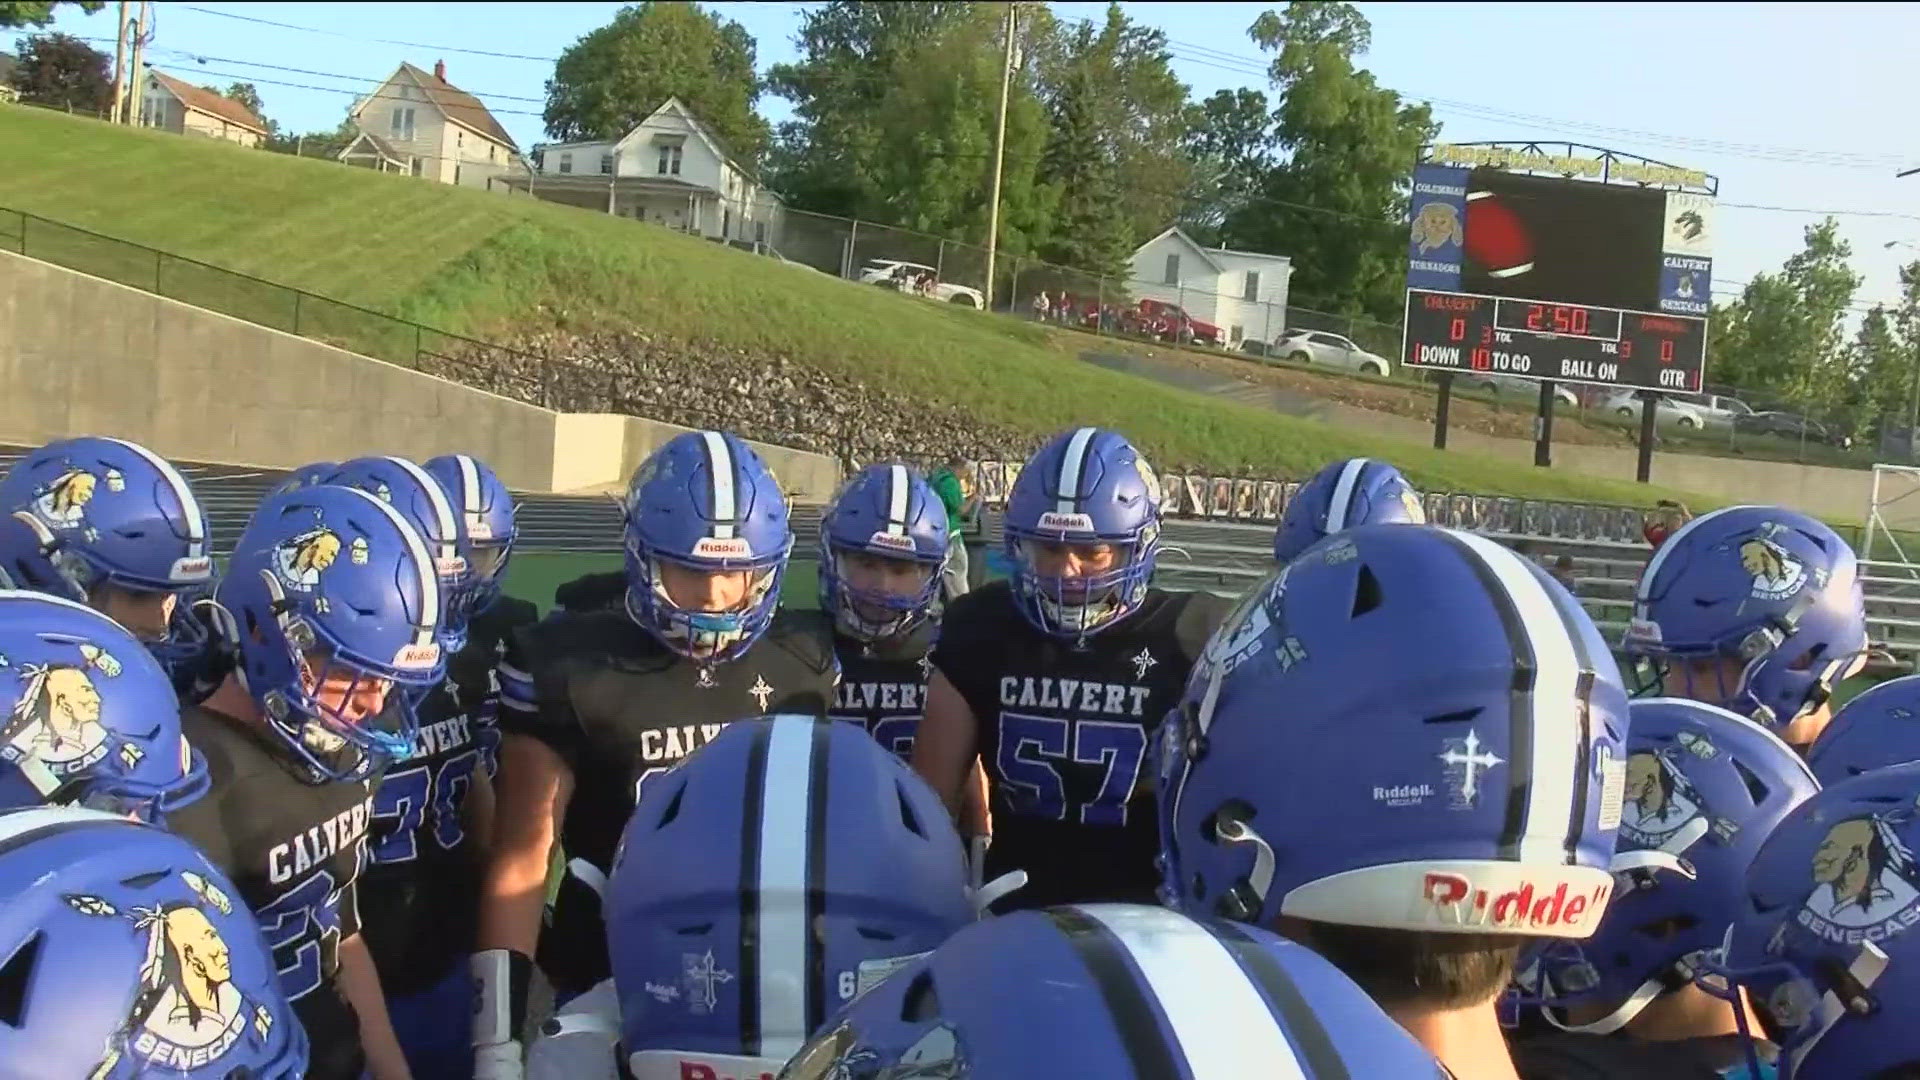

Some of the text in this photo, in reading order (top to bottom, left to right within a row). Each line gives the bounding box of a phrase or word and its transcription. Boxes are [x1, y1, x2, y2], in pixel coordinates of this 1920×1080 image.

[1663, 257, 1710, 271] CALVERT
[1451, 319, 1465, 341] 0
[1527, 304, 1587, 334] 2:50
[1495, 331, 1513, 343] TOL
[1601, 342, 1619, 354] TOL
[1421, 345, 1460, 366] DOWN
[1492, 351, 1531, 373] TO GO
[1661, 340, 1673, 362] 0
[1561, 359, 1618, 381] BALL ON
[1659, 369, 1686, 388] QTR
[1000, 676, 1151, 716] CALVERT
[997, 712, 1149, 828] 57
